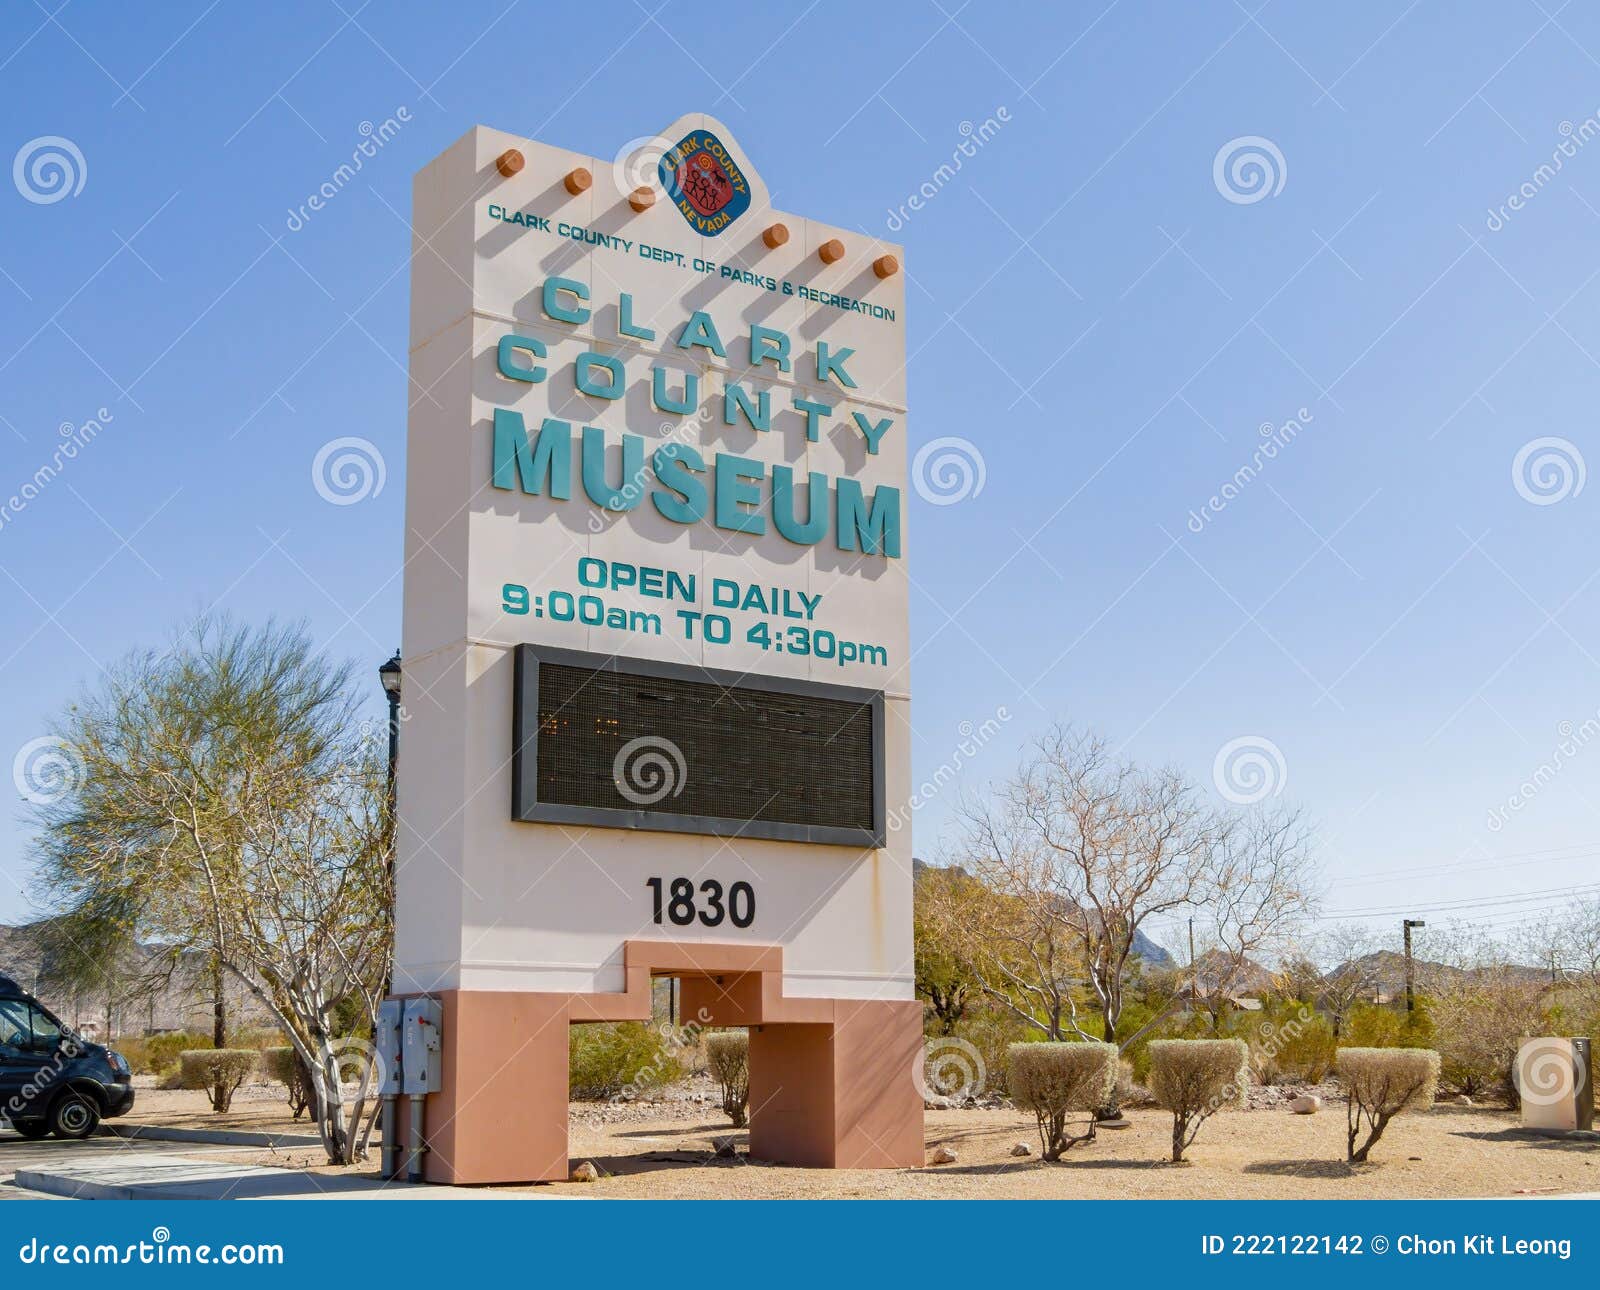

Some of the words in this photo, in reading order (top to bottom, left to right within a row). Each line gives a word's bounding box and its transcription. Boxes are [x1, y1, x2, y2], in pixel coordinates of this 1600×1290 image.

[664, 137, 701, 172] CLARK
[703, 138, 746, 194] COUNTY
[679, 199, 731, 232] NEVADA
[488, 204, 551, 233] CLARK
[557, 222, 633, 253] COUNTY
[639, 243, 687, 268] DEPT.
[692, 258, 716, 275] OF
[720, 265, 777, 292] PARKS
[782, 281, 794, 296] &
[798, 284, 896, 322] RECREATION
[542, 276, 857, 389] CLARK
[496, 333, 895, 456] COUNTY
[493, 407, 901, 559] MUSEUM
[501, 583, 662, 636] 9:00am
[676, 609, 732, 646] TO
[746, 621, 889, 668] 4:30pm
[578, 556, 696, 603] OPEN
[712, 578, 823, 621] DAILY
[646, 877, 756, 929] 1830
